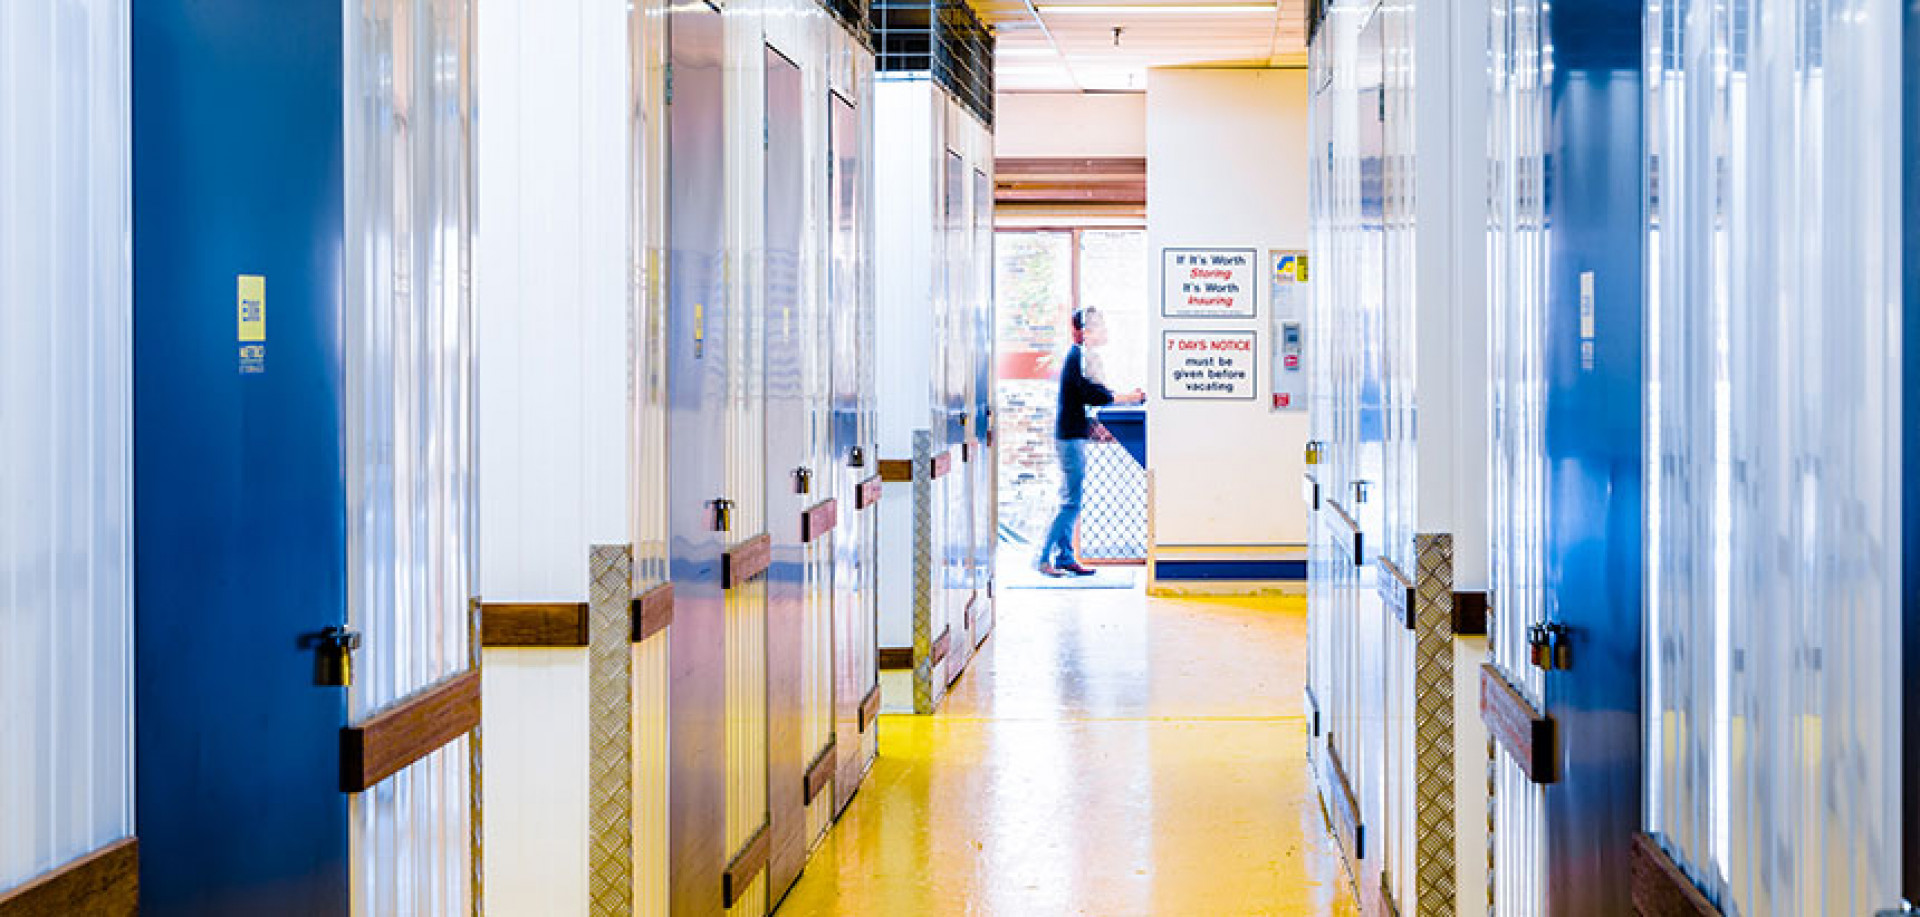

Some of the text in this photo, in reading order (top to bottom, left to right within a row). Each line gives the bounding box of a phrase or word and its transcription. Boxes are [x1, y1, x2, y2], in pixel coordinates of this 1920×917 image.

[1176, 255, 1185, 265] If
[1210, 255, 1246, 265] Worth
[1190, 267, 1233, 280] Storing
[1205, 283, 1240, 292] Worth
[1187, 296, 1233, 308] Insuring
[1167, 339, 1251, 350] 7 DAYS NOTICE
[1185, 356, 1233, 367] must be
[1173, 369, 1246, 381] given before
[1185, 382, 1234, 393] vacating
